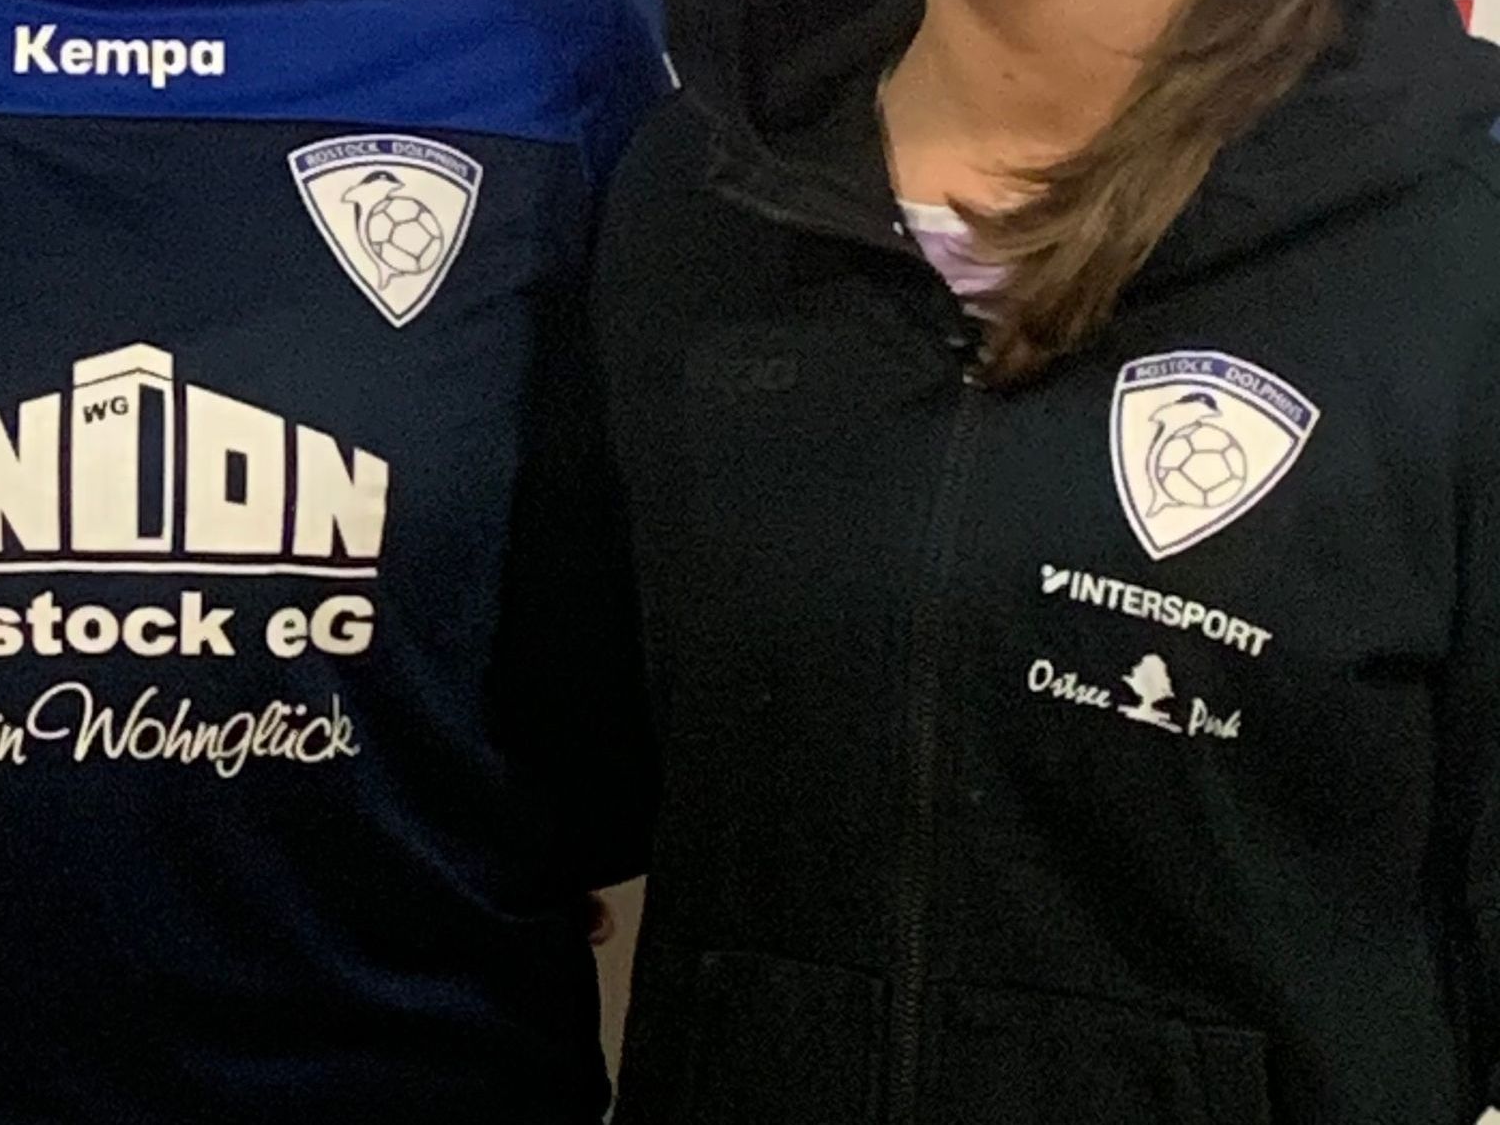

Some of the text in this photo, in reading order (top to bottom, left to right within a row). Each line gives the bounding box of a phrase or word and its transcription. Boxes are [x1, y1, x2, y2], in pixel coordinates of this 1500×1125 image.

[13, 24, 225, 89] Kempa
[83, 396, 130, 426] WG
[266, 596, 376, 657] eG
[1069, 570, 1273, 658] INTERSPORT
[26, 682, 362, 780] Wohnglück
